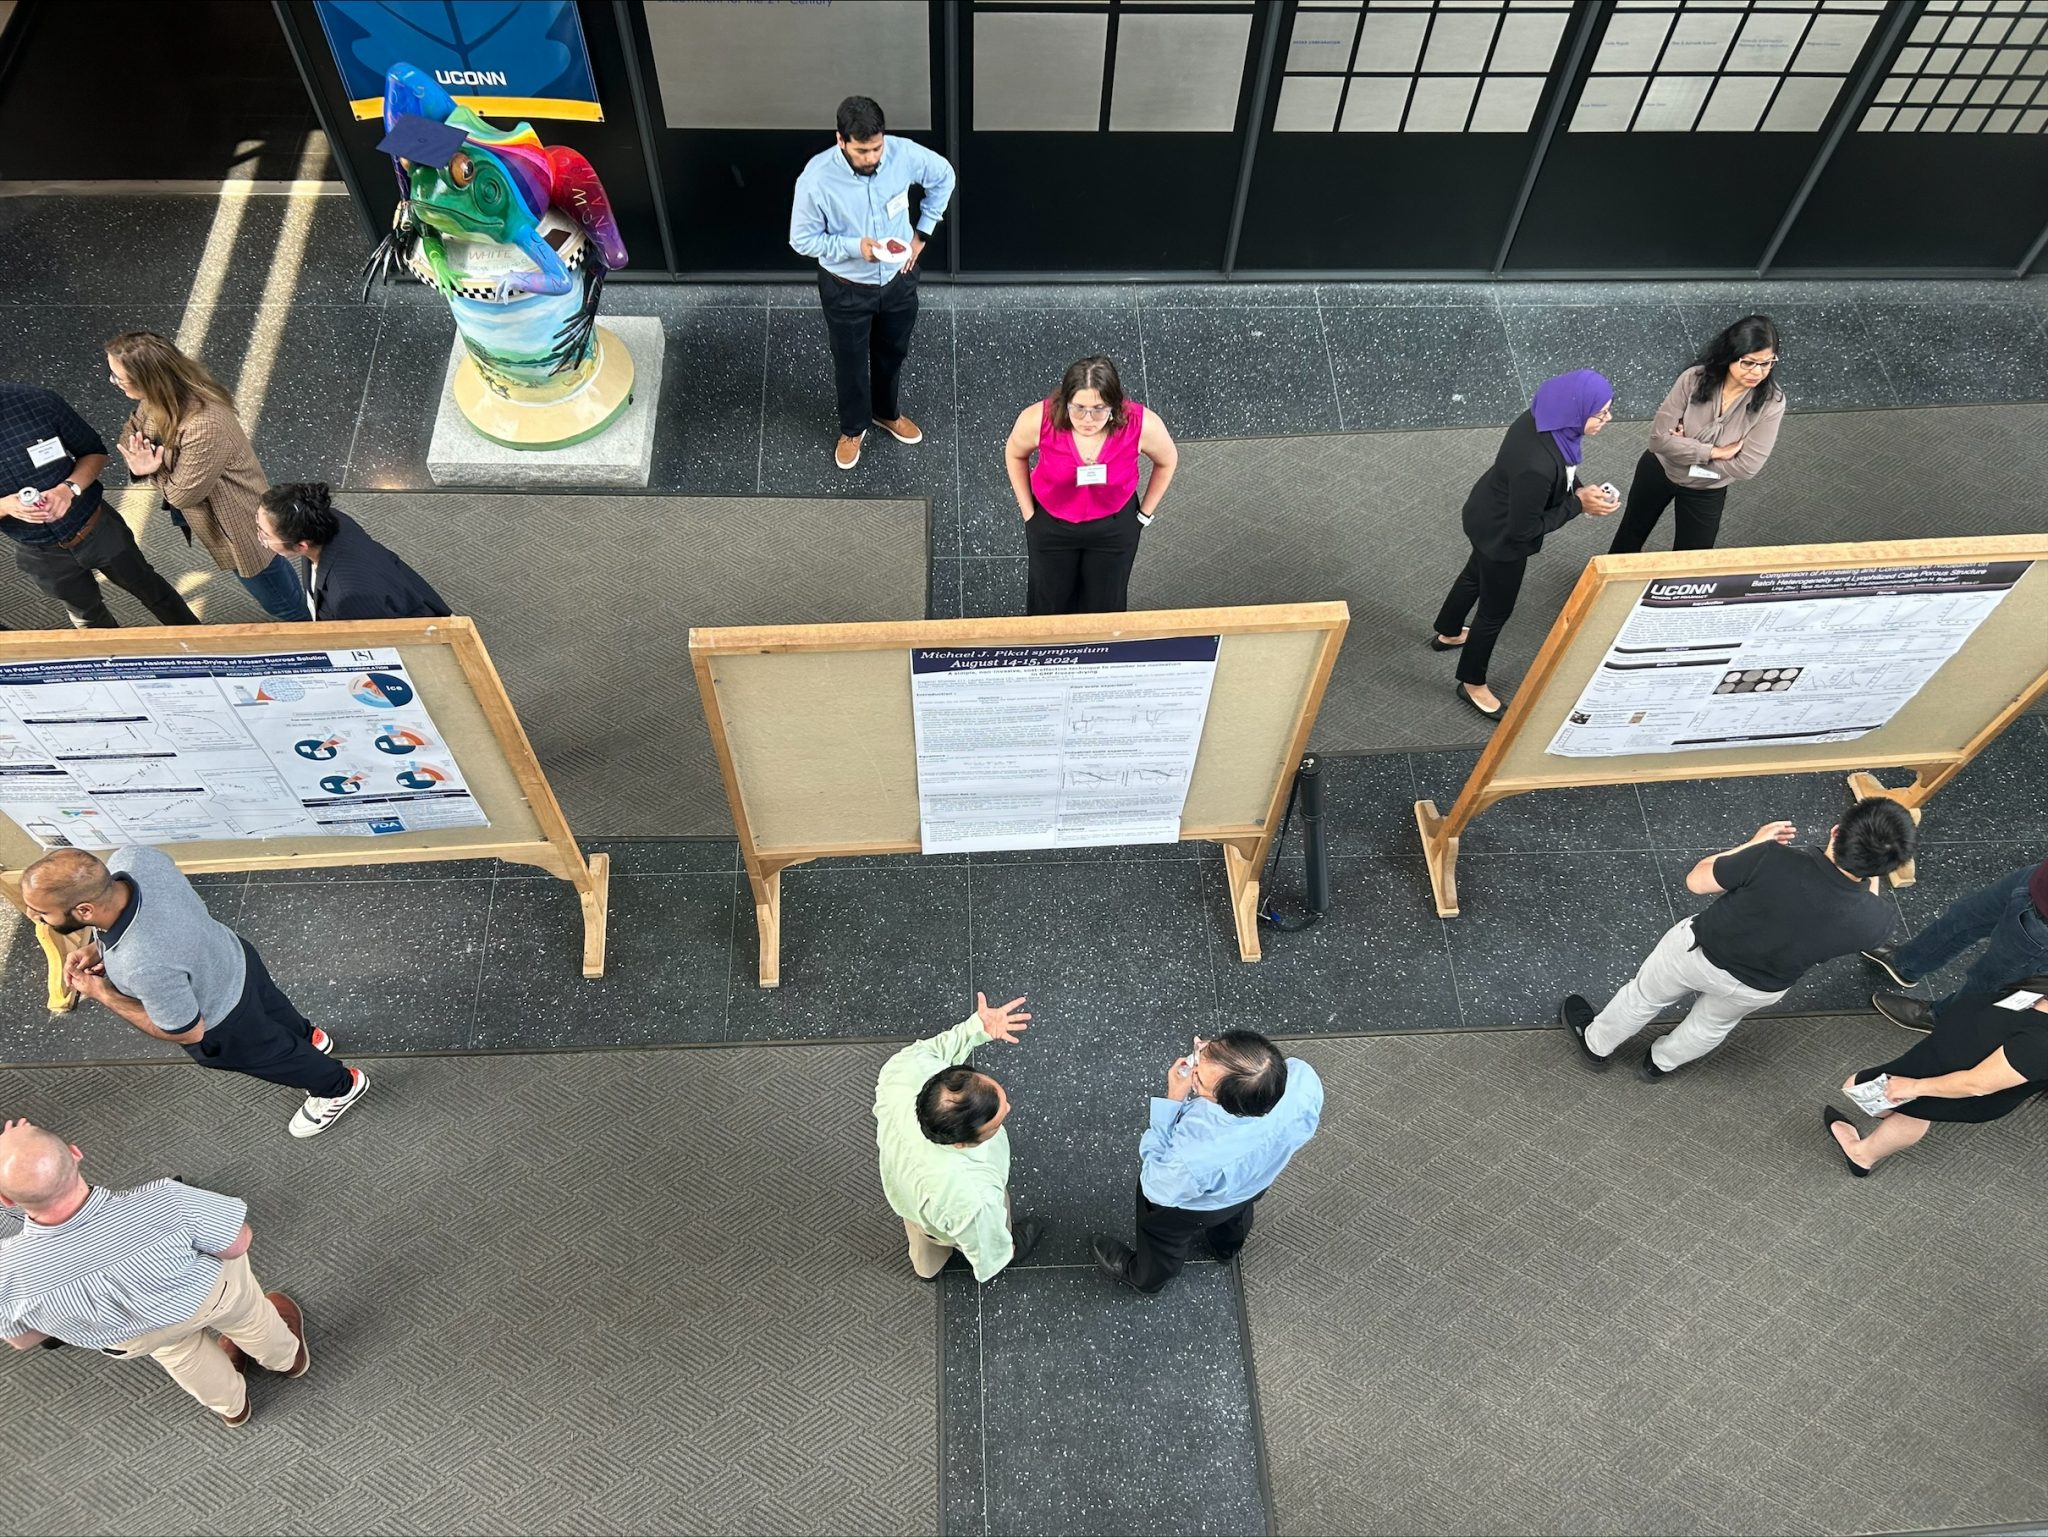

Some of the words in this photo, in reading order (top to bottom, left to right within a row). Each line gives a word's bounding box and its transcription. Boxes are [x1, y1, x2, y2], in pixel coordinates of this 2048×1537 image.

[434, 69, 507, 86] UCONN
[1776, 577, 1834, 586] Heterogeneity
[1650, 582, 1718, 596] UCONN
[920, 650, 976, 659] Michael
[977, 650, 990, 658] J.
[994, 649, 1029, 657] Pikal
[1031, 646, 1109, 657] symposium
[39, 662, 94, 671] Concentration
[950, 659, 999, 669] August
[1002, 658, 1041, 667] 14-15,
[1043, 656, 1079, 665] 2024
